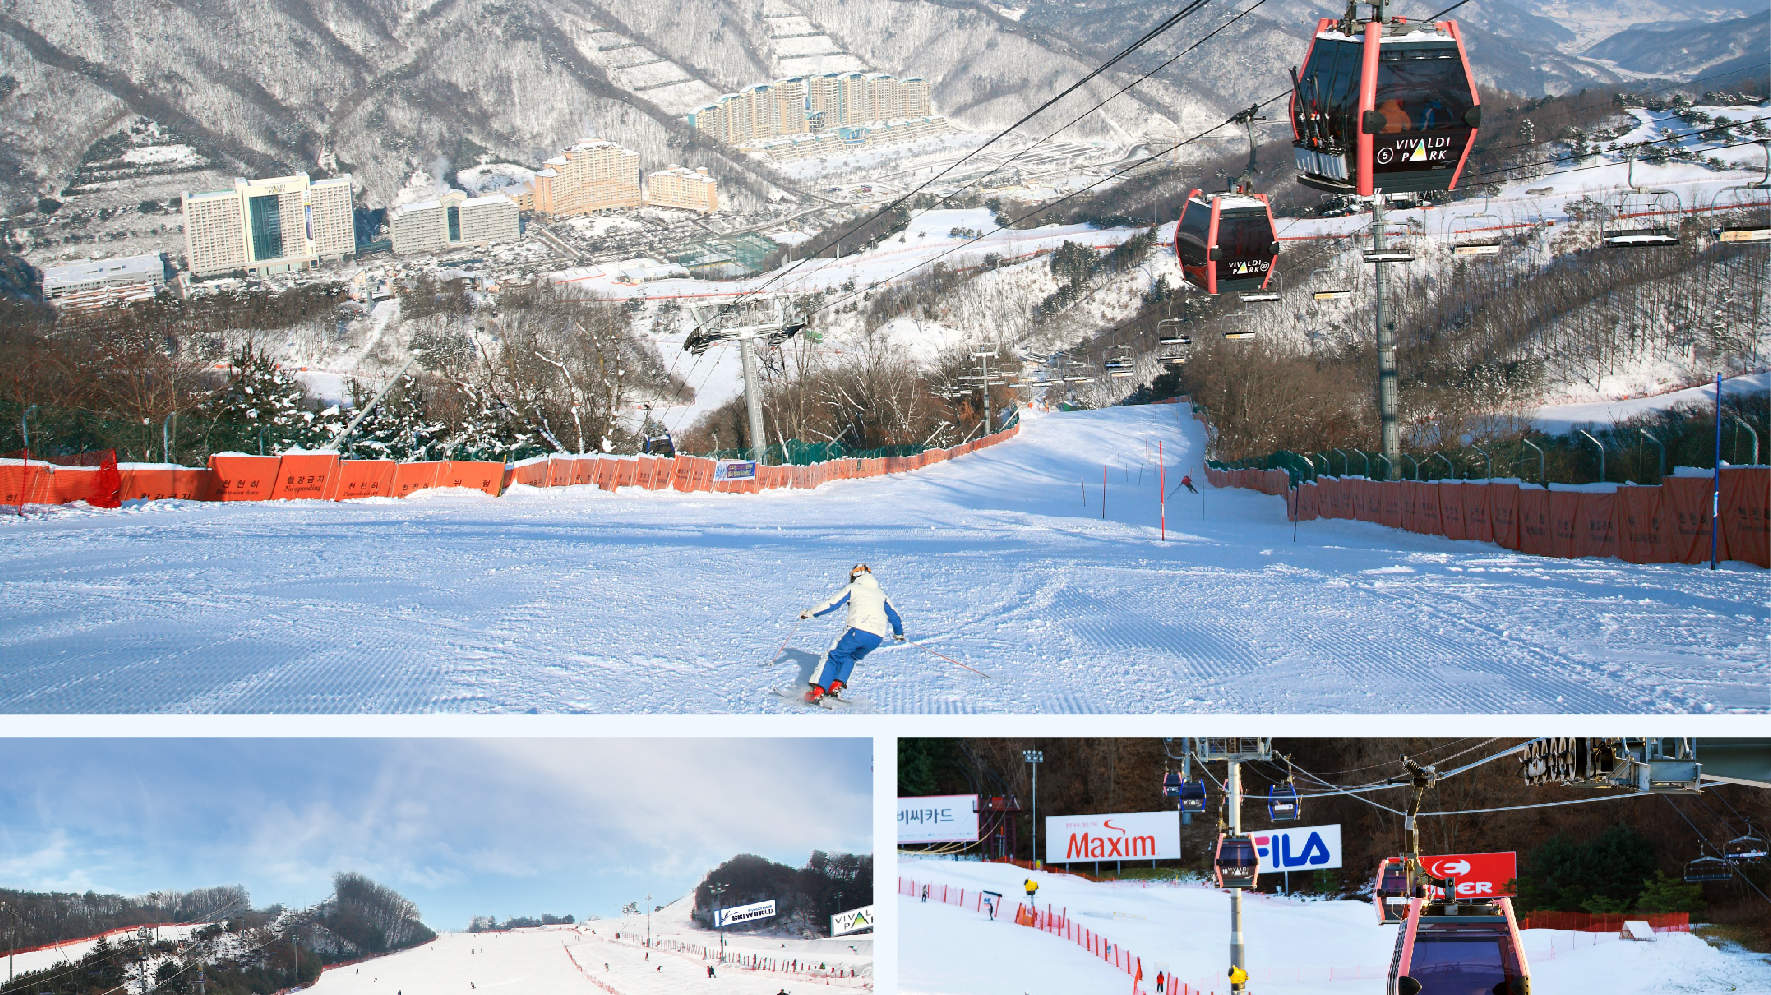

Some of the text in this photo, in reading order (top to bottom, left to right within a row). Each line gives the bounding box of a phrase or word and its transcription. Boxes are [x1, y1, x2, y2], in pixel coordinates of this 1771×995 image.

[1396, 136, 1451, 150] VIVALDI
[1401, 148, 1447, 162] PARK
[1229, 260, 1262, 269] VIVALDI
[1233, 265, 1259, 275] PARK
[897, 808, 954, 825] 비씨카드
[1066, 832, 1156, 859] Maxim
